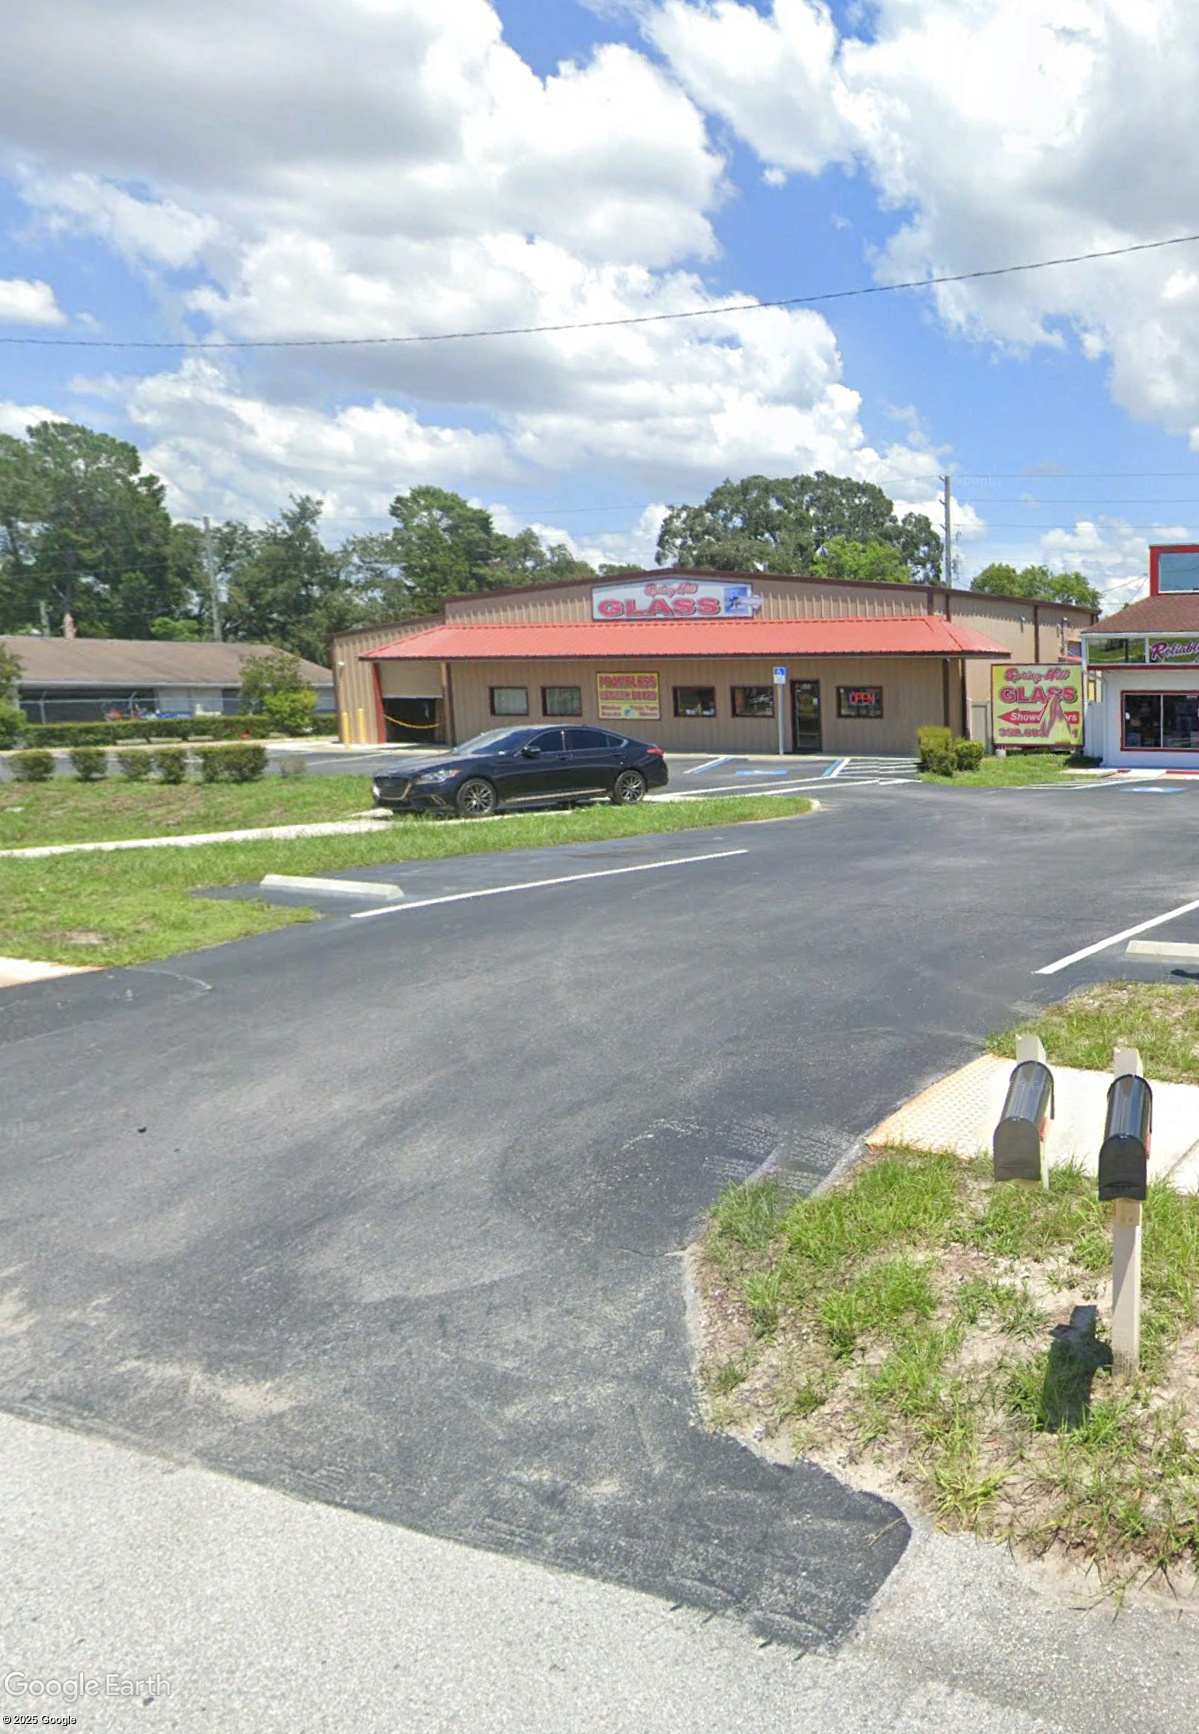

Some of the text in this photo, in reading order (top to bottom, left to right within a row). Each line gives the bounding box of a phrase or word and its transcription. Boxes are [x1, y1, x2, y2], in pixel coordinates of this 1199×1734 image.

[597, 597, 722, 617] GLASS
[1003, 667, 1071, 684] Spring Hill
[849, 692, 876, 705] OPEN
[999, 685, 1079, 705] GLASS
